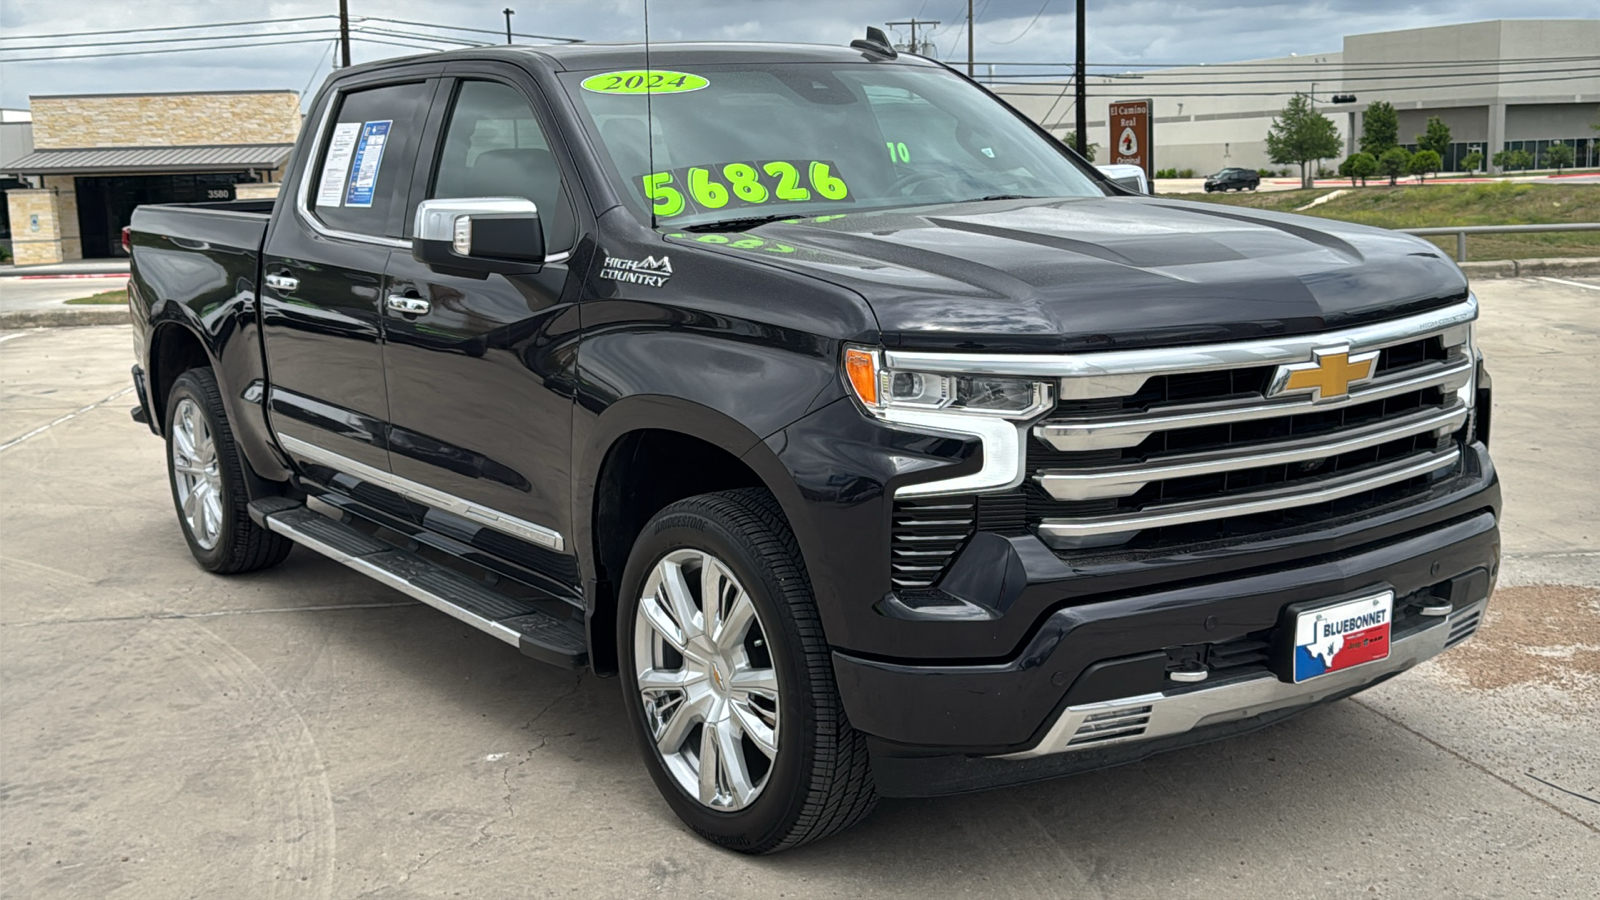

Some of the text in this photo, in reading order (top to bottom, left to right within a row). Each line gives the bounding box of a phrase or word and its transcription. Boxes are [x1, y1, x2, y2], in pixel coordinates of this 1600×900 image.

[602, 74, 687, 91] 2024
[1110, 105, 1146, 116] El Camino
[1120, 117, 1137, 127] Real
[207, 189, 229, 199] 3580
[642, 160, 848, 217] 56826
[603, 256, 639, 270] HIGH
[599, 268, 670, 288] COUNTRY
[654, 515, 709, 535] BRIDGESTONE
[1323, 609, 1386, 637] BLUEBONNET
